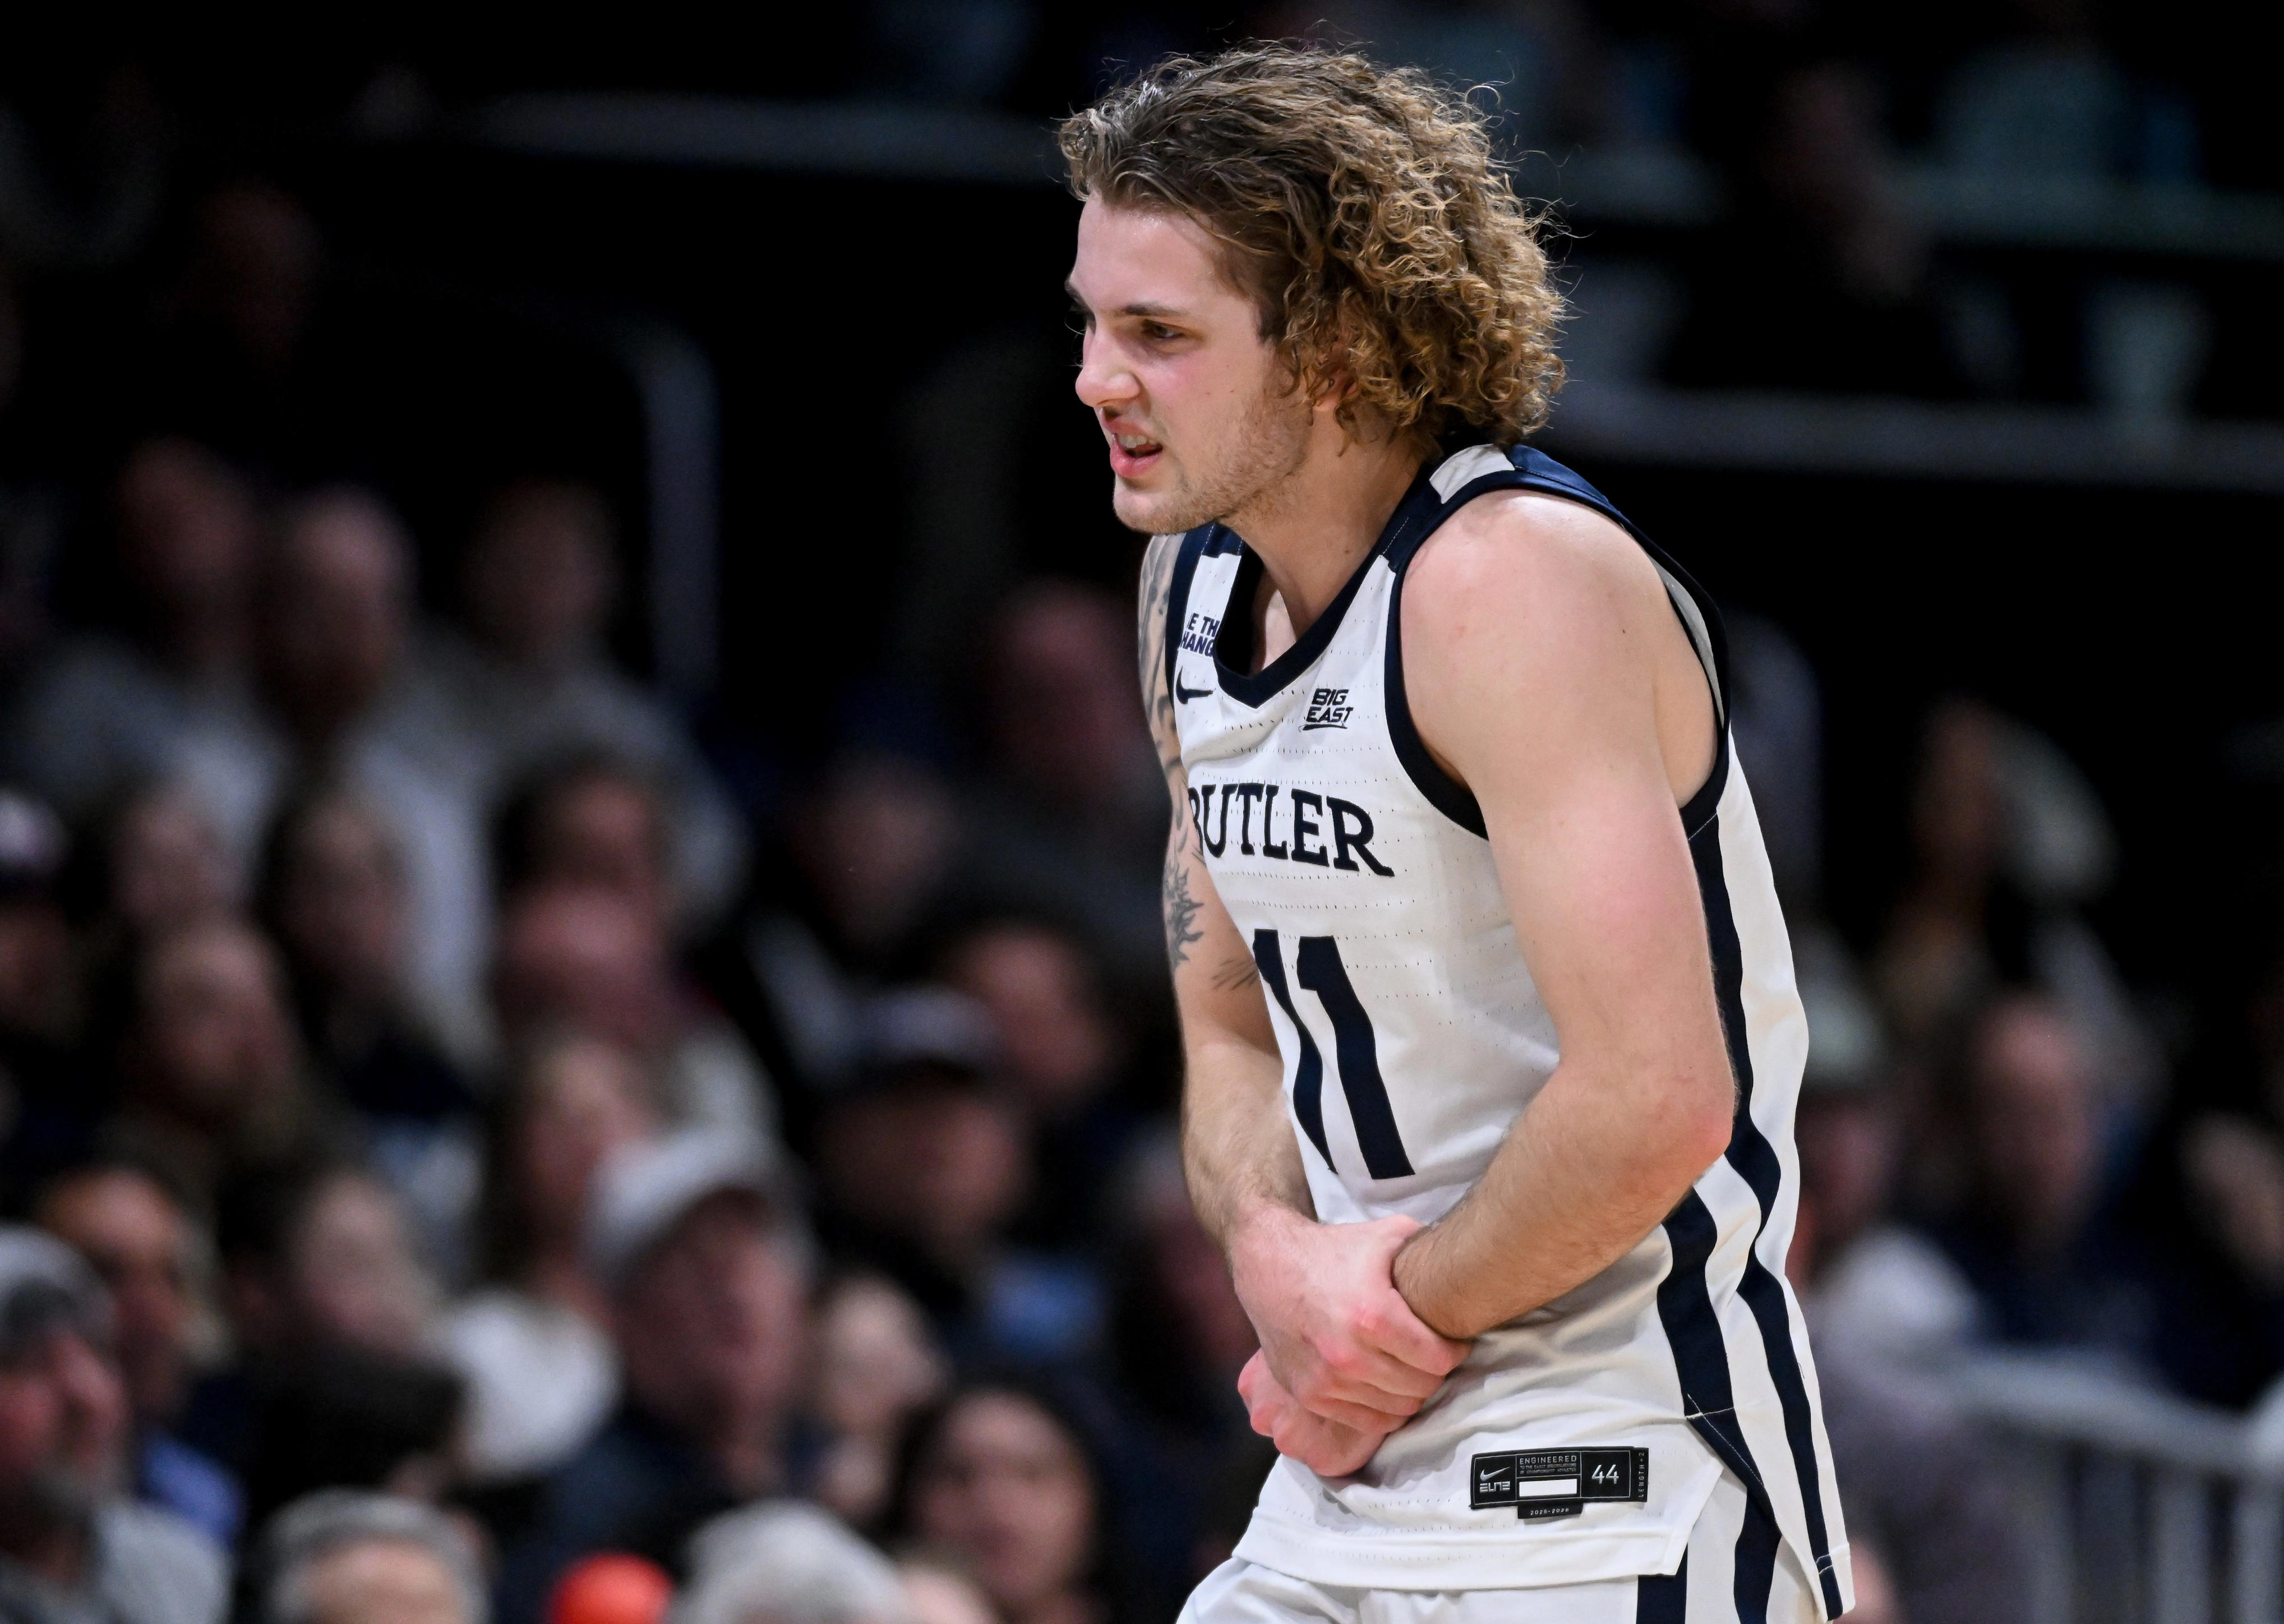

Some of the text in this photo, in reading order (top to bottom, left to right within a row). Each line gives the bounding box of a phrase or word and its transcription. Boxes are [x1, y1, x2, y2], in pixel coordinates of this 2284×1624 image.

[1187, 612, 1220, 638] E TH
[1180, 631, 1215, 657] HANG
[1311, 689, 1350, 706] BIG
[1306, 707, 1354, 723] EAST
[1252, 928, 1416, 1180] 11
[1519, 1455, 1577, 1465] ENGINEERED
[1591, 1464, 1619, 1484] 44
[1530, 1507, 1569, 1516] 2025-2026
